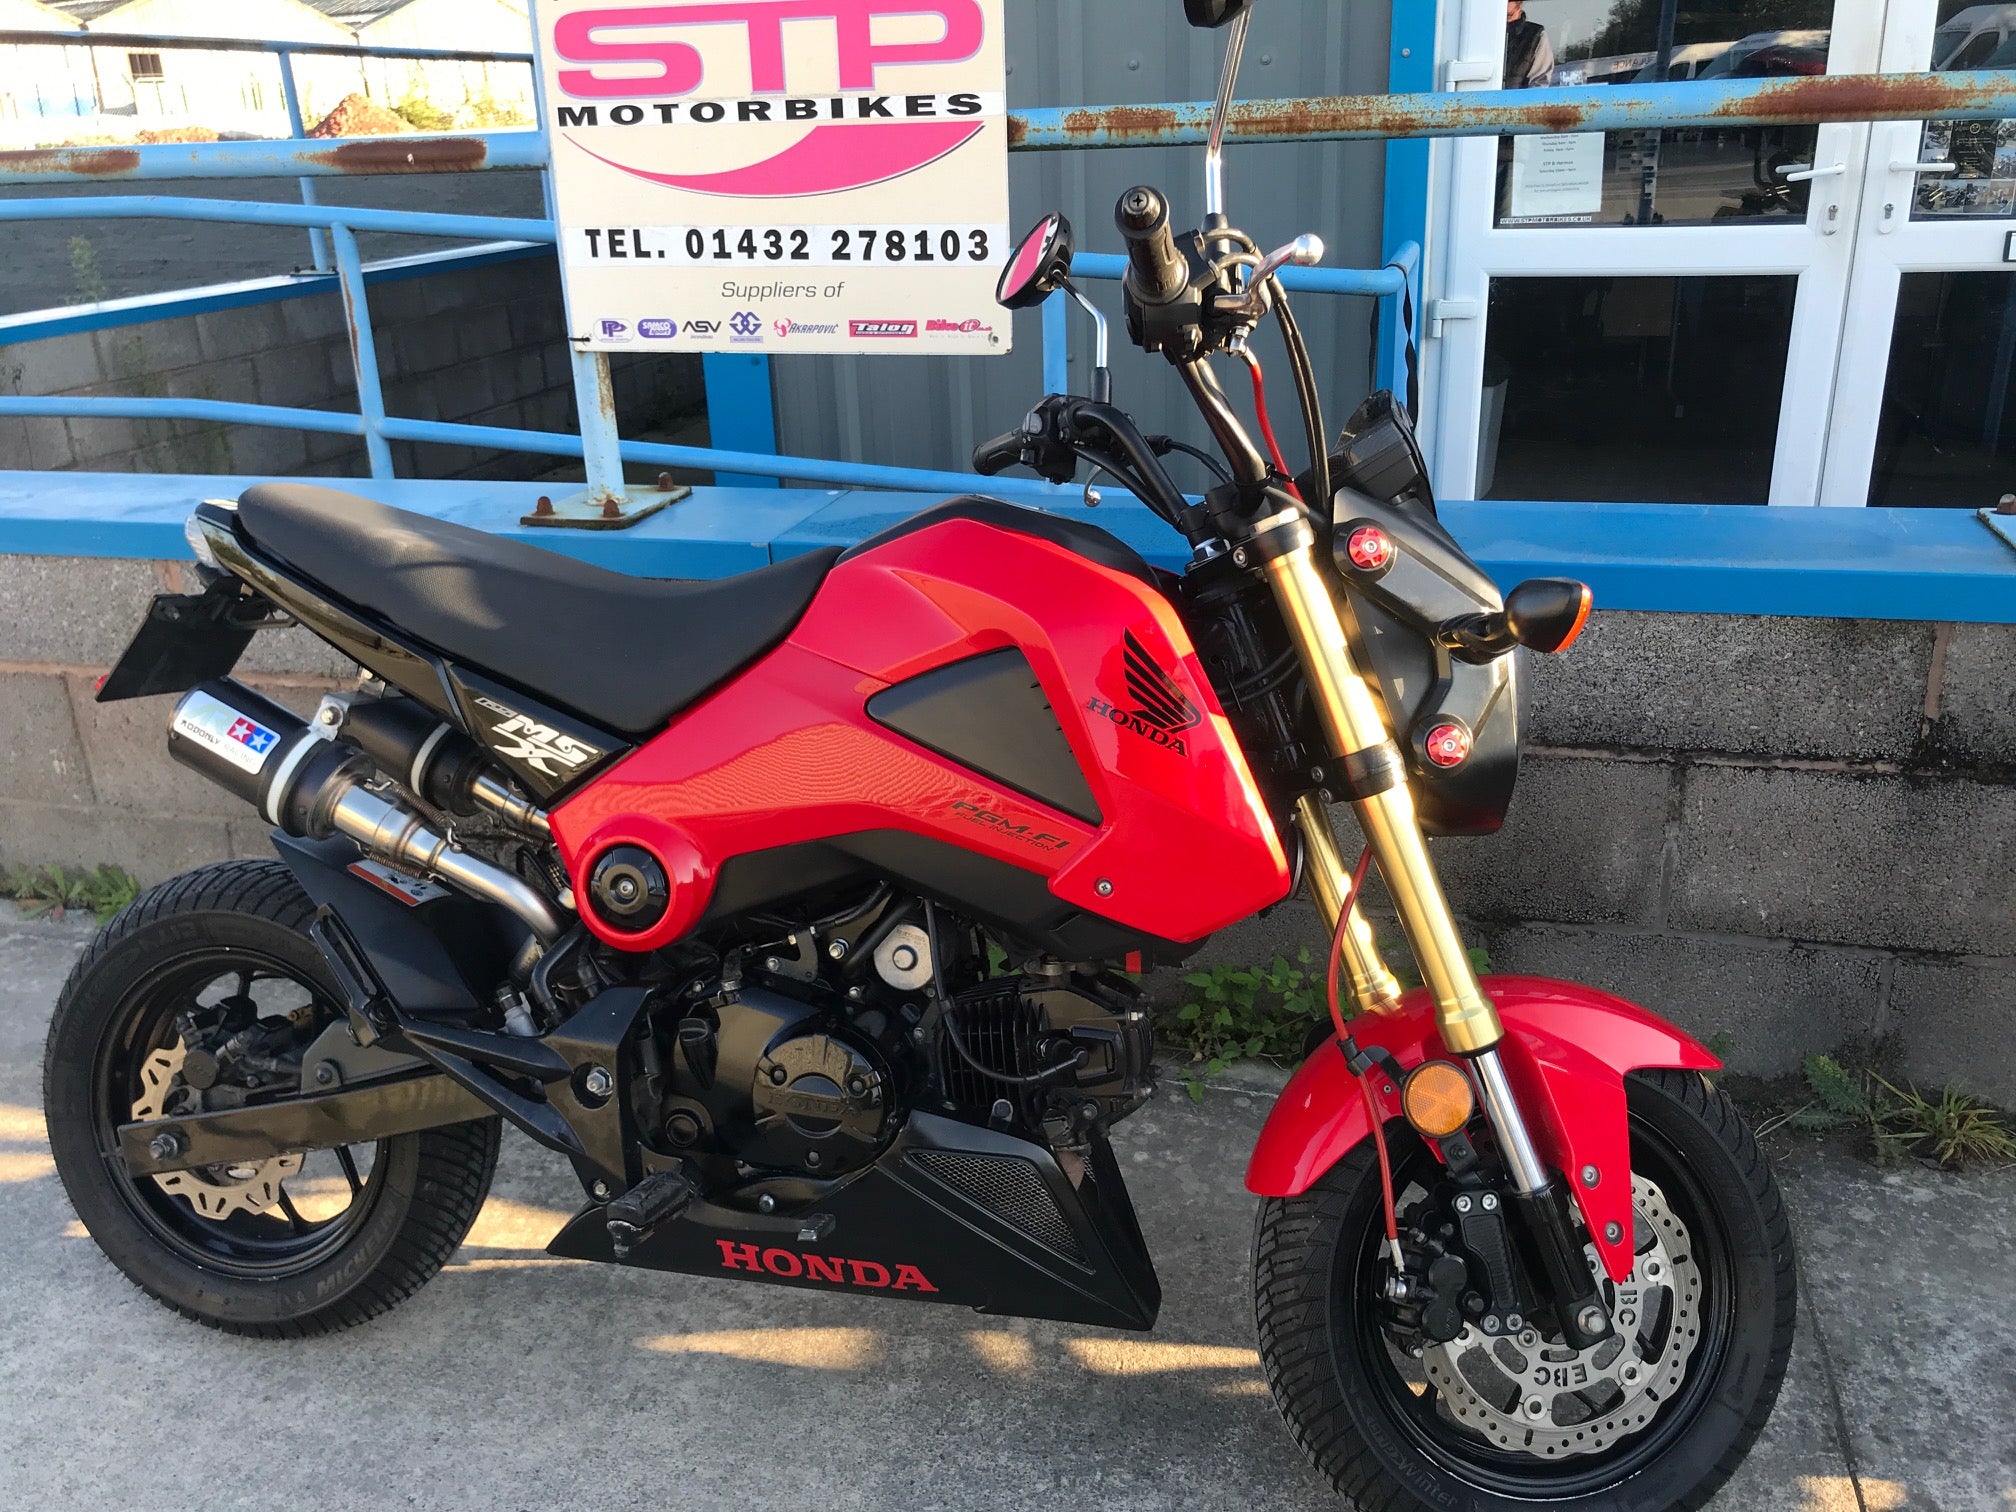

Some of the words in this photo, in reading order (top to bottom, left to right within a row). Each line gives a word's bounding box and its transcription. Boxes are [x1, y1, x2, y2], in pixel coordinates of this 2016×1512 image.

[552, 0, 985, 100] STP
[557, 93, 982, 127] MOTORBIKES
[585, 229, 666, 258] TEL.
[685, 229, 809, 260] 01432
[831, 230, 989, 261] 278103
[721, 282, 817, 302] Suppliers
[824, 282, 845, 298] of
[682, 321, 722, 333] ASV
[852, 323, 914, 335] Talon
[1087, 697, 1188, 757] HONDA
[989, 825, 1054, 852] INJECTION
[716, 1239, 939, 1292] HONDA
[1534, 1363, 1587, 1387] EBC
